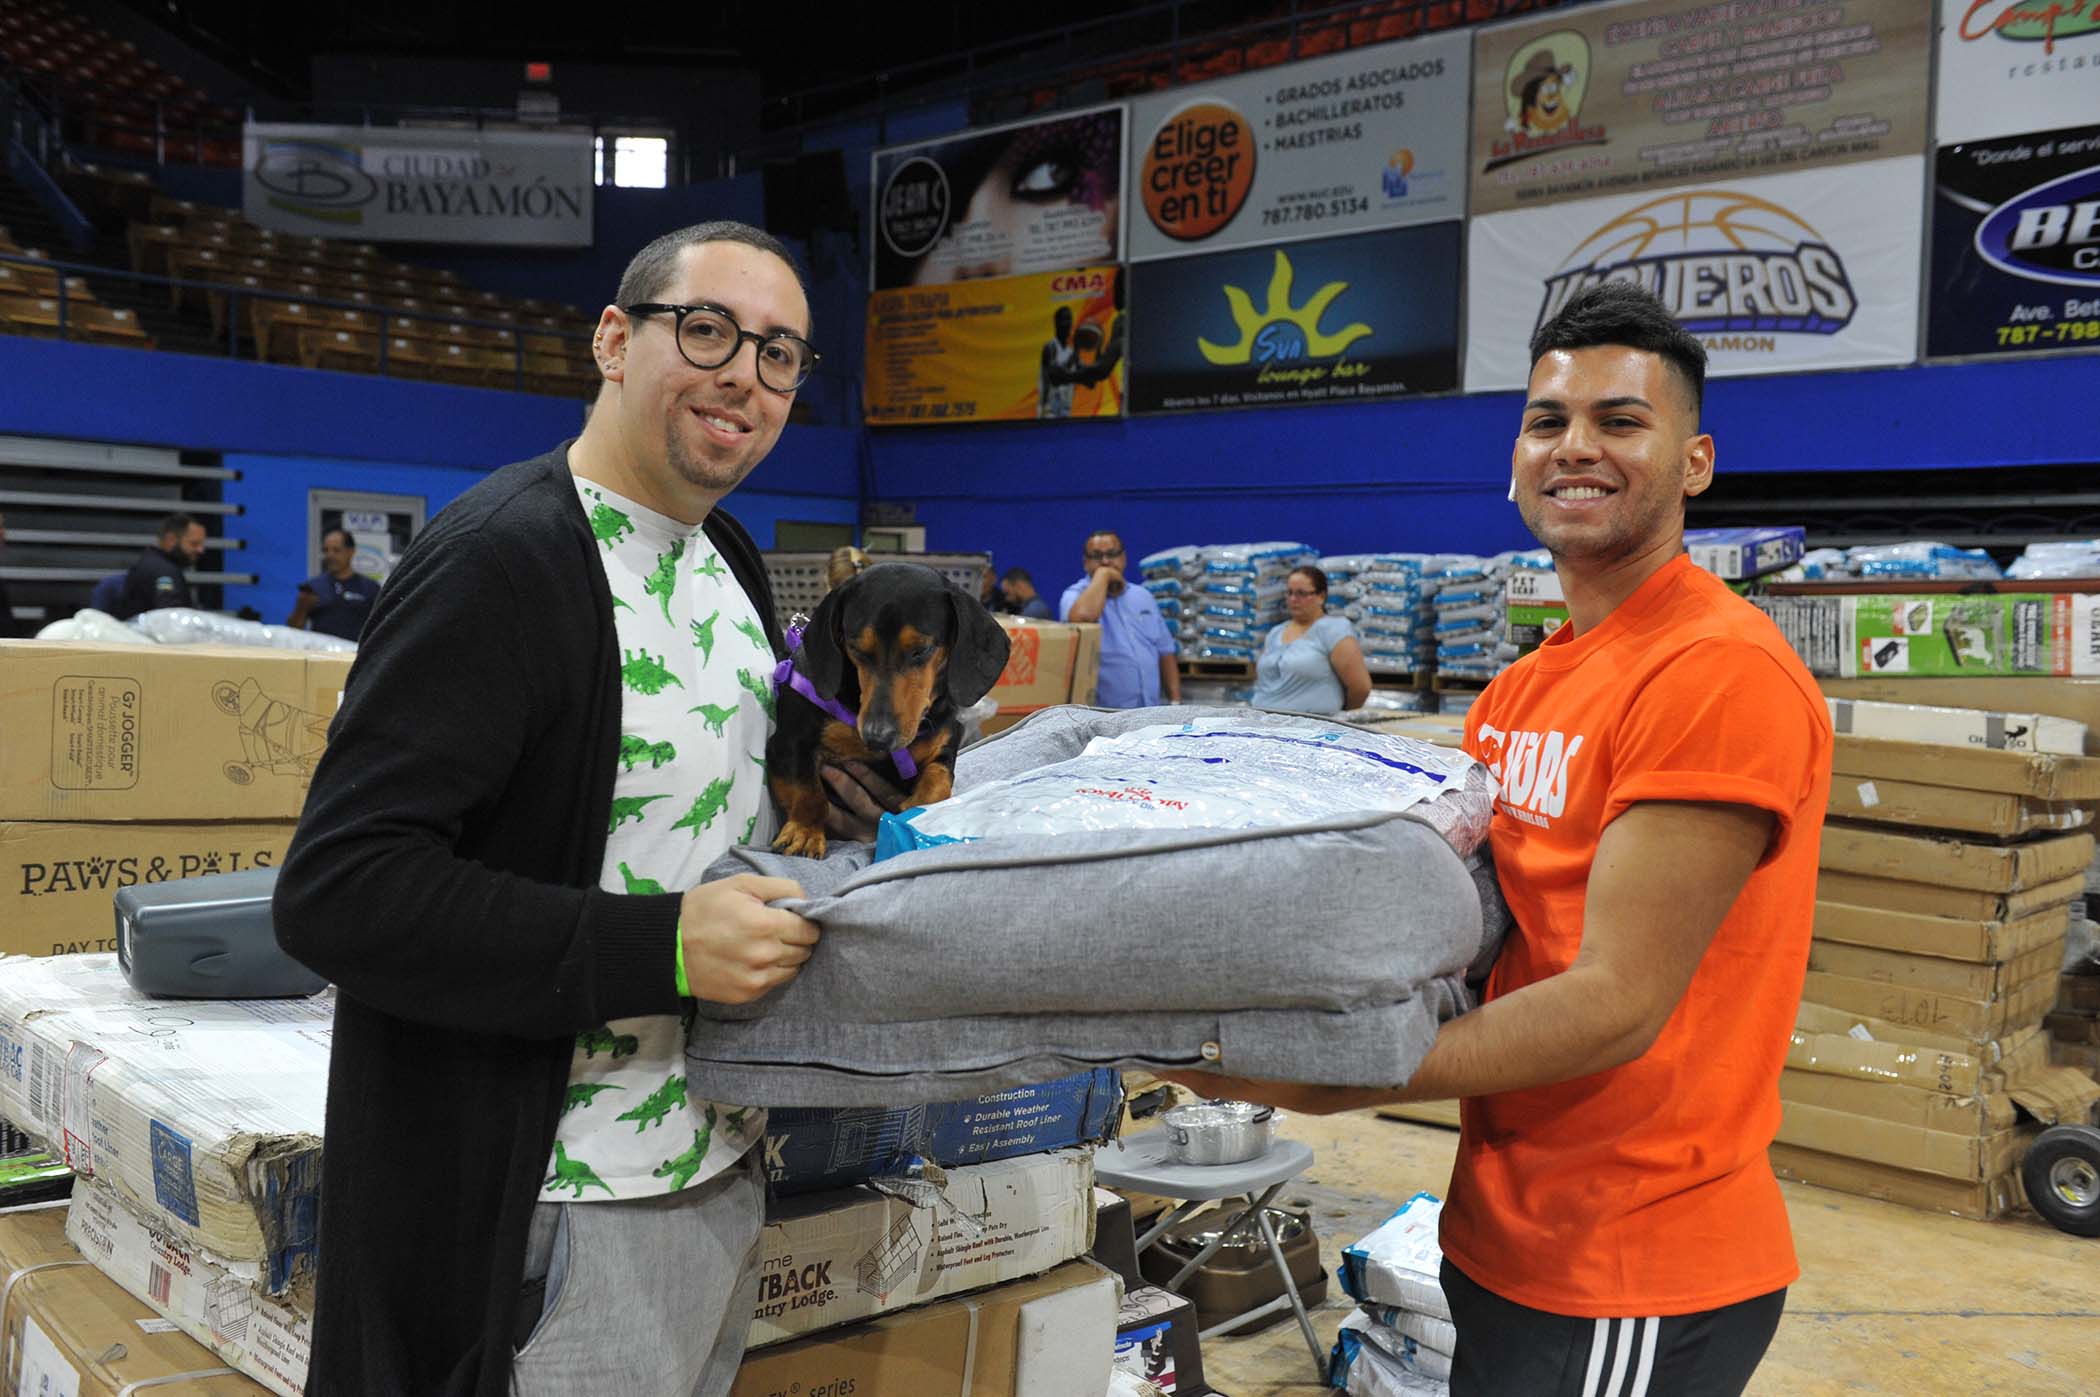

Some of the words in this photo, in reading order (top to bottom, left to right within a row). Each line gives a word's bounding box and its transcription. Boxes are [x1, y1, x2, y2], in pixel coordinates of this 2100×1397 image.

[1276, 77, 1342, 105] GRADOS
[1346, 58, 1446, 91] ASOCIADOS
[1275, 91, 1405, 129] BACHILLERATOS
[1154, 119, 1239, 160] Elige
[1274, 122, 1363, 150] MAESTRIAS
[383, 154, 491, 179] CIUDAD
[1151, 152, 1241, 192] creer
[386, 176, 582, 219] BAYAMÓN
[1160, 193, 1199, 223] en
[1205, 175, 1227, 217] ti
[1052, 273, 1106, 293] CMA
[122, 691, 136, 709] G7
[20, 856, 138, 896] PAWS
[145, 856, 172, 884] &
[52, 941, 90, 956] DAY
[978, 1088, 1036, 1105] Construction
[975, 1110, 1011, 1122] Durable
[1013, 1103, 1050, 1117] Weather
[972, 1122, 1014, 1136] Resistant
[1016, 1117, 1038, 1129] Roof
[992, 1134, 1036, 1150] Assembly
[791, 1289, 838, 1311] Lodge.
[809, 1377, 856, 1397] series
